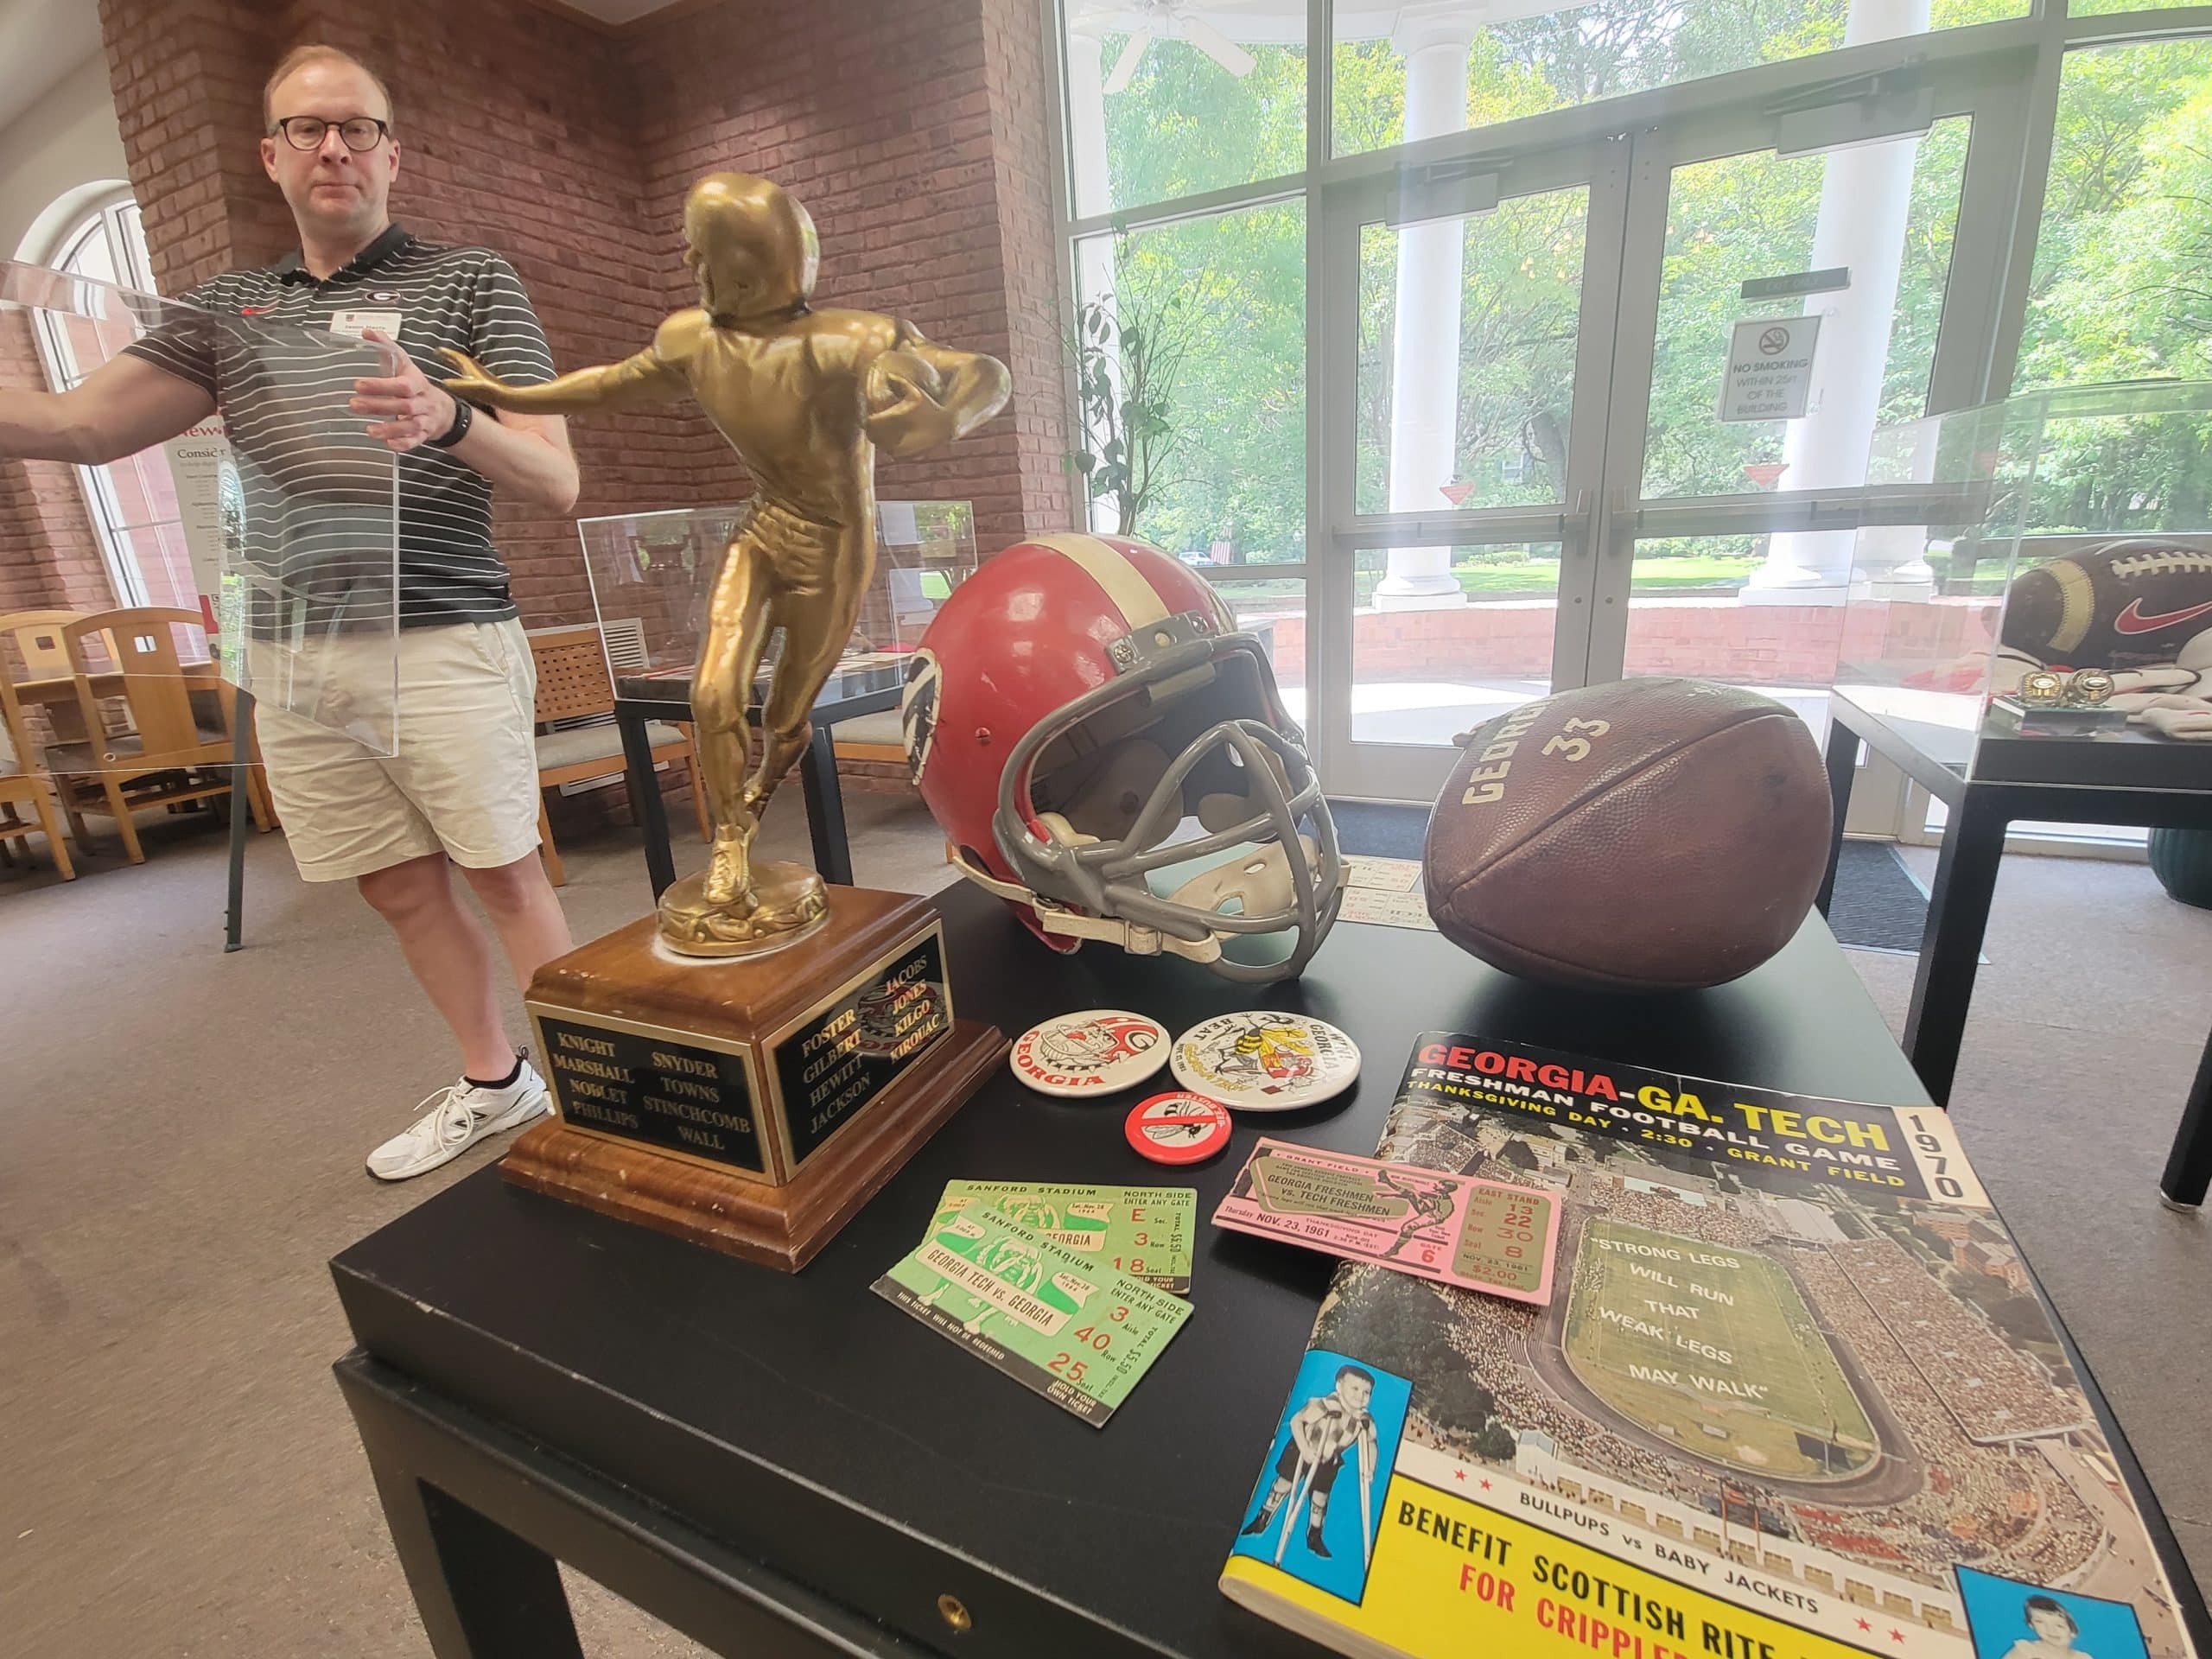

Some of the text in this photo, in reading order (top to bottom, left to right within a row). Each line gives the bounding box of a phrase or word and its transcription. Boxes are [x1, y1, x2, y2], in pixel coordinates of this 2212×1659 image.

[1733, 359, 1808, 373] NO SMOKING
[1737, 376, 1773, 387] WITHIN
[1746, 388, 1784, 400] OF THE
[1737, 403, 1788, 415] BUILDING
[1541, 717, 1611, 762] 33
[885, 955, 927, 995] JACOBS
[893, 979, 927, 1014] JONES
[802, 1008, 857, 1058] FOSTER
[894, 1000, 931, 1037] KILGO
[1193, 1018, 1234, 1040] BEAT
[556, 1032, 615, 1058] KNIGHT
[889, 1014, 940, 1065] KIROUAC
[1309, 1024, 1340, 1070] GEORGIA
[552, 1053, 635, 1084] MARSHALL
[652, 1052, 718, 1078] SNYDER
[804, 1029, 862, 1084] GILBERT
[1017, 1030, 1106, 1086] GEORGIA
[661, 1077, 720, 1103] TOWNS
[809, 1053, 863, 1108] HEWITT
[573, 1102, 639, 1129] PHILLIPS
[643, 1096, 751, 1134] STINCHCOMB
[810, 1072, 871, 1135] JACKSON
[1407, 1081, 1906, 1187] THANKSGIVING DAY 2:30 GRANT FIELD
[1410, 1068, 1901, 1171] FRESHMAN FOOTBALL GAME
[1733, 1103, 1890, 1151] TECH
[678, 1126, 725, 1150] WALL
[1286, 1154, 1321, 1165] GRANT
[1327, 1163, 1360, 1173] FIELD
[1909, 1114, 1964, 1198] 1970
[967, 1184, 1096, 1196] SANFORD STADIUM
[1268, 1174, 1312, 1192] GEORGIA
[1314, 1184, 1374, 1204] FRESHMEN
[1280, 1187, 1295, 1198] VS.
[1299, 1191, 1328, 1205] TECH
[1329, 1197, 1390, 1217] FRESHMEN
[1478, 1188, 1540, 1205] EAST STAND
[1131, 1208, 1147, 1222] E
[1225, 1205, 1331, 1238] Thursday NOV. 23, 1961
[1503, 1213, 1532, 1229] 22
[1510, 1204, 1534, 1216] 13
[1134, 1232, 1148, 1246] 3
[1306, 1217, 1361, 1234] THANKSGIVING
[1467, 1224, 1534, 1243] Row 30
[982, 1211, 1034, 1241] SANFORD
[1039, 1242, 1095, 1272] STADIUM
[1421, 1249, 1435, 1263] 6
[1505, 1246, 1522, 1259] 8
[1471, 1264, 1518, 1281] $2.00
[1506, 1263, 1529, 1272] 1961
[1689, 1252, 1741, 1269] LEGS
[927, 1249, 1054, 1327] GEORGIA TECH VS. GEORGIA
[1116, 1279, 1185, 1316] NORTH SIDE
[1629, 1262, 1735, 1306] WILL RUN
[1109, 1306, 1130, 1322] 3
[1110, 1287, 1177, 1325] ENTER ANY GATE
[1643, 1300, 1700, 1319] THAT
[897, 1291, 910, 1303] THIS
[910, 1299, 932, 1316] TICKET
[932, 1313, 950, 1326] WILL
[949, 1322, 962, 1335] NOT
[972, 1337, 1005, 1360] REDEEMED
[1074, 1326, 1111, 1351] 40
[1122, 1323, 1140, 1336] Aisle
[1599, 1306, 1733, 1365] WEAK LEGS
[1101, 1350, 1116, 1363] Row
[1116, 1326, 1159, 1375] TOTAL $5.50
[1047, 1352, 1089, 1381] 25
[1629, 1363, 1679, 1384] MAY
[1052, 1380, 1097, 1408] HOLD YOUR
[1077, 1378, 1094, 1393] Seat
[1046, 1386, 1093, 1415] OWN TICKET
[1519, 1491, 1611, 1537] BULLPUPS
[1655, 1543, 1712, 1576] BABY
[1724, 1570, 1819, 1614] JACKETS
[1398, 1500, 1513, 1567] BENEFIT
[1532, 1554, 1686, 1641] SCOTTISH
[1459, 1562, 1516, 1612] FOR
